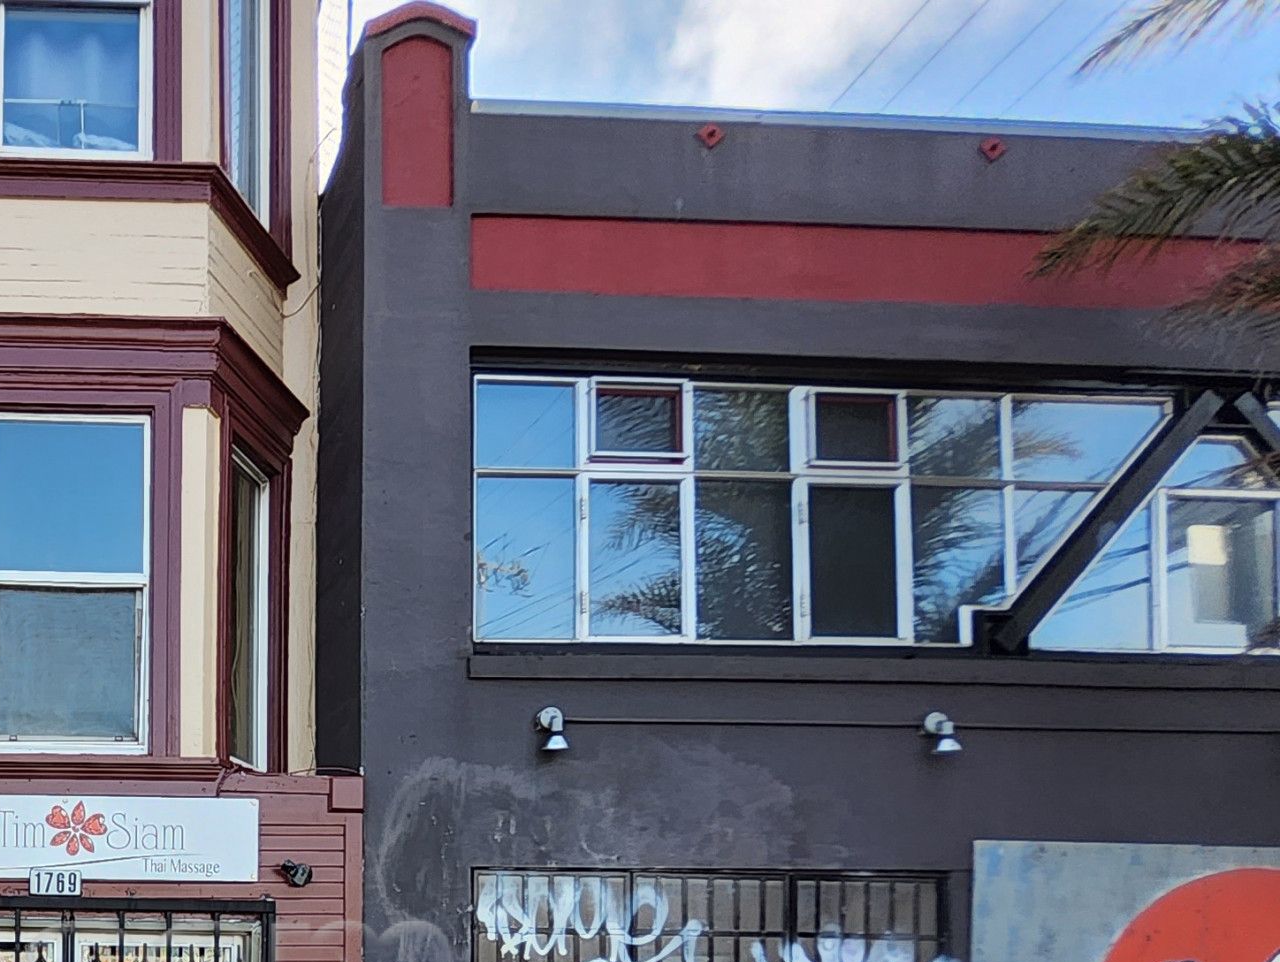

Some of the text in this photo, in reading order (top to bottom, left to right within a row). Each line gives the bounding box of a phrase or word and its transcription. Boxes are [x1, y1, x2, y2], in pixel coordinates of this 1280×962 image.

[106, 812, 184, 850] Siam
[142, 857, 221, 877] Thai Massage
[34, 871, 77, 894] 1769
